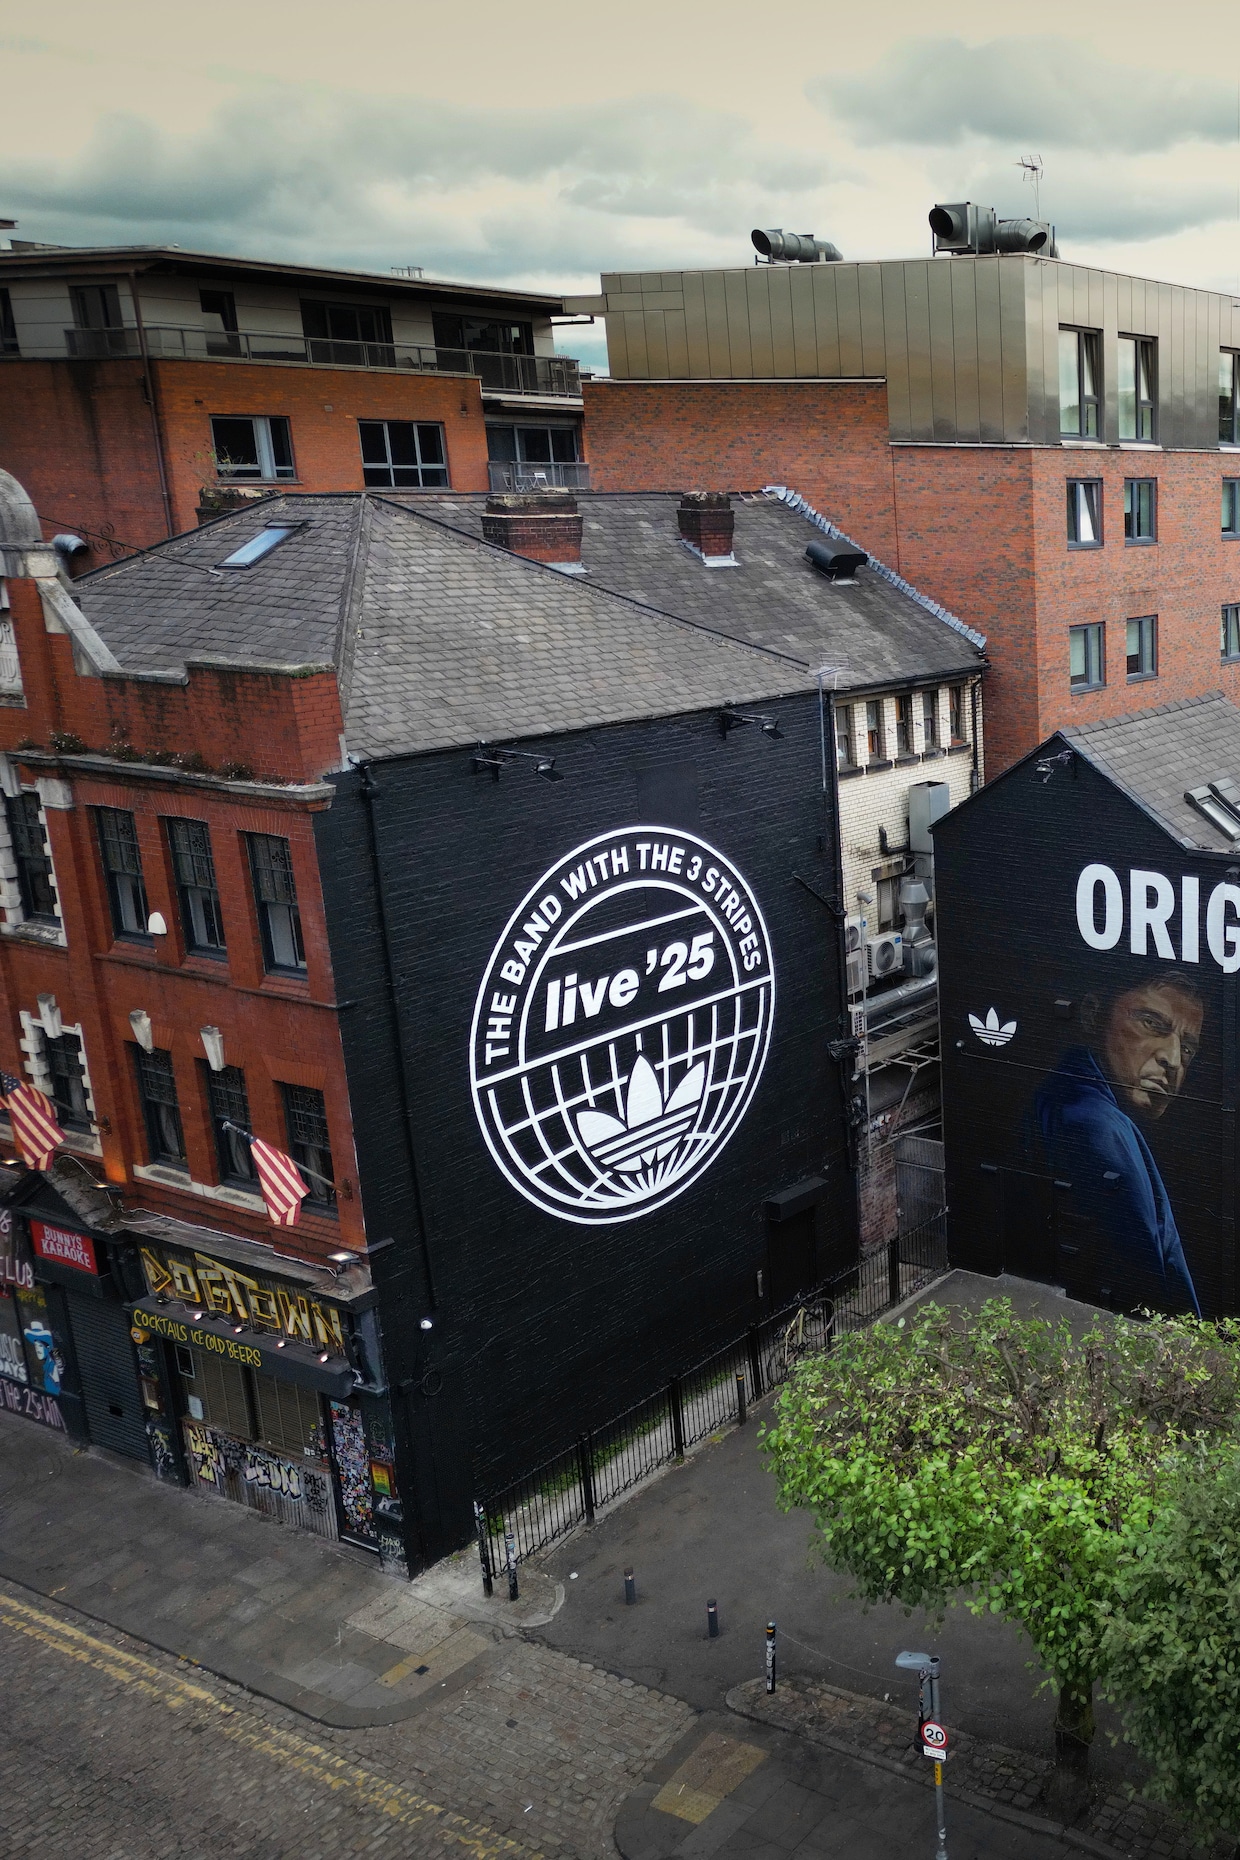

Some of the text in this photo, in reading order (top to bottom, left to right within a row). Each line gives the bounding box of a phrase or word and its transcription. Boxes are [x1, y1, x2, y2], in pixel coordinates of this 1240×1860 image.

[486, 843, 762, 1066] THE BAND WITH THE 3 STRIPES
[544, 969, 640, 1033] live
[41, 1239, 91, 1269] KARAOKE
[43, 1225, 83, 1251] BUNNY'S
[141, 1247, 344, 1347] DOGTOWN
[133, 1309, 262, 1367] COCKTAILS ICE COLD BEERS
[926, 1728, 944, 1742] 20
